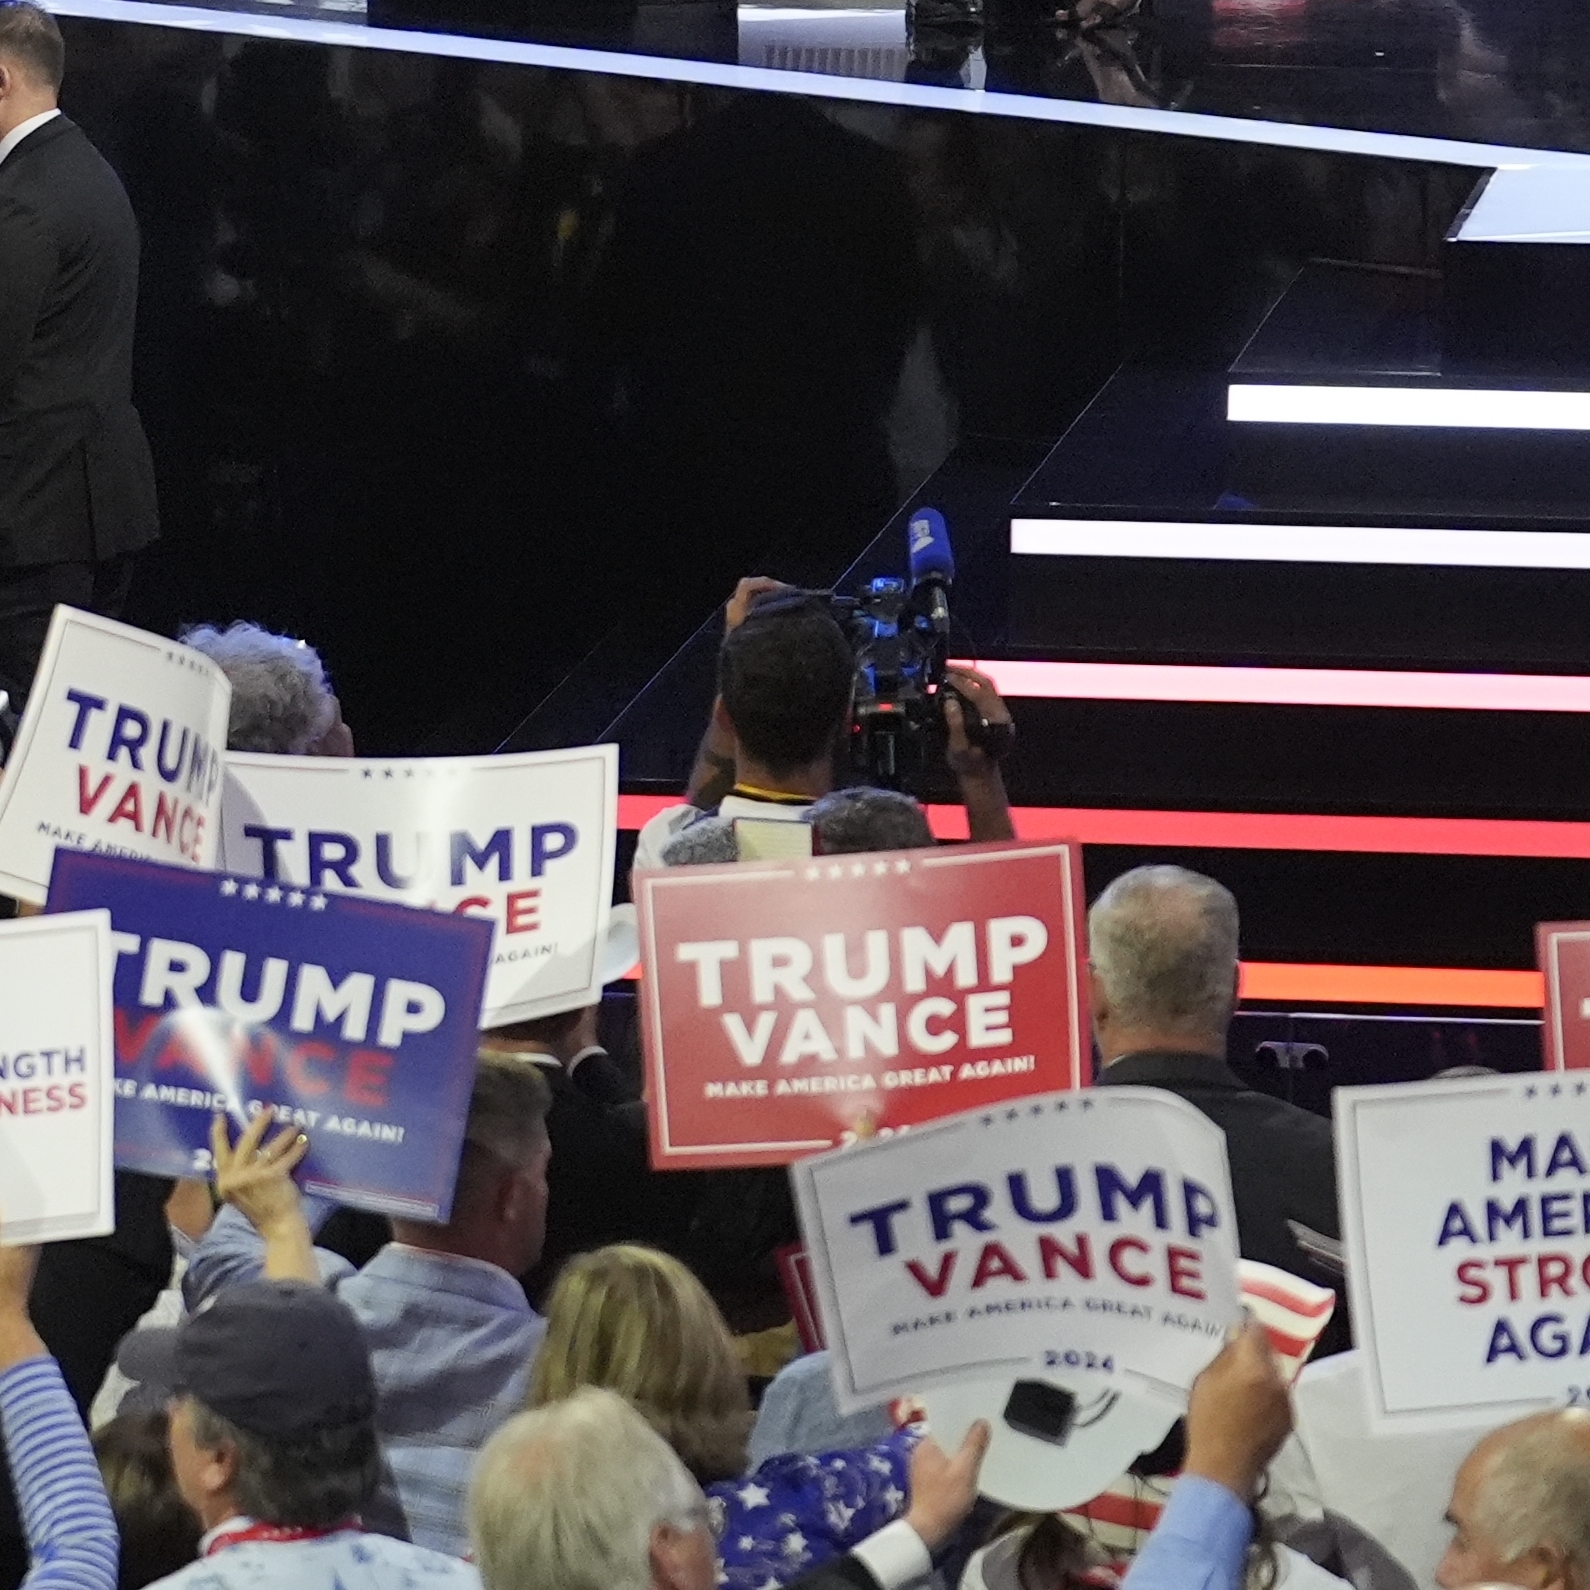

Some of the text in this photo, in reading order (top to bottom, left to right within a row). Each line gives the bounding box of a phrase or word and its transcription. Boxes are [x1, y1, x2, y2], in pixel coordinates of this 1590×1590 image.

[64, 686, 219, 810] TRUMP
[36, 821, 88, 846] MAKE
[75, 763, 206, 865] VANCE
[244, 821, 580, 890] TRUMP
[495, 942, 559, 964] AGAIN!
[676, 914, 1049, 1010] TRUMP
[722, 990, 1013, 1068] VANCE
[705, 1055, 1035, 1099] MAKE AMERICA GREAT AGAIN!
[142, 1082, 230, 1110] AMERIC
[247, 1098, 322, 1129] GEAT
[323, 1113, 405, 1145] AGAIN!
[1489, 1130, 1590, 1183] MA
[849, 1162, 1220, 1259] TRUMP
[1437, 1190, 1590, 1248] AME
[905, 1233, 1208, 1301] VANCE
[1456, 1253, 1590, 1304] STR
[890, 1308, 958, 1337] MAKE
[967, 1296, 1076, 1318] AMERICA
[1084, 1296, 1154, 1321] GREAT
[1485, 1313, 1590, 1363] AG
[1044, 1350, 1117, 1373] 2024
